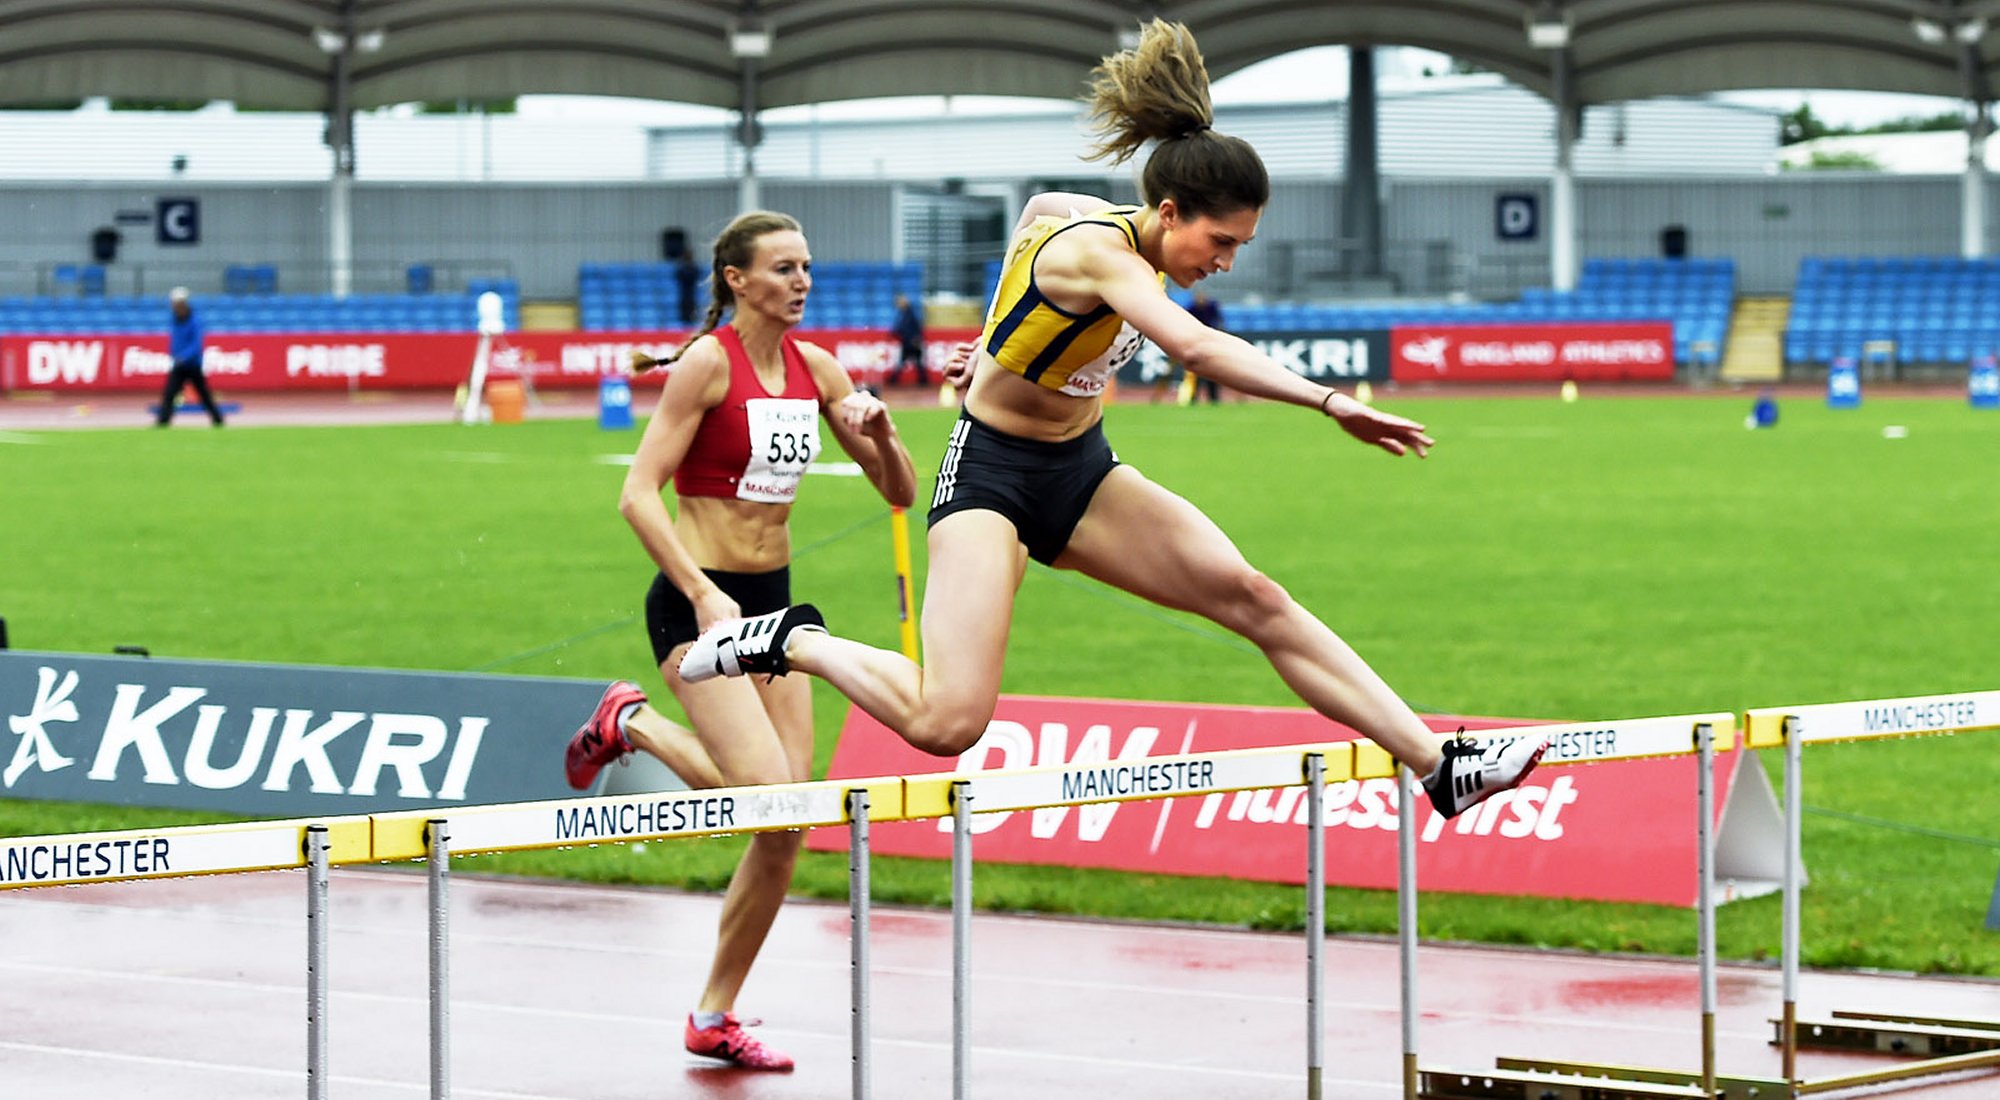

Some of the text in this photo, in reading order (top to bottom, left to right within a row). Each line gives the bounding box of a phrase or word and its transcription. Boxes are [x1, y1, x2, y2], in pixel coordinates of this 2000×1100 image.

[165, 205, 190, 239] C
[1503, 200, 1530, 233] D
[28, 341, 103, 384] DW
[287, 344, 385, 377] PRIDE
[767, 432, 811, 464] 535
[1864, 700, 1977, 731] MANCHESTER
[87, 683, 491, 801] KUKRI
[1062, 759, 1215, 801] MANCHESTER
[556, 796, 735, 840] MANCHESTER
[0, 838, 170, 882] NCHESTER
